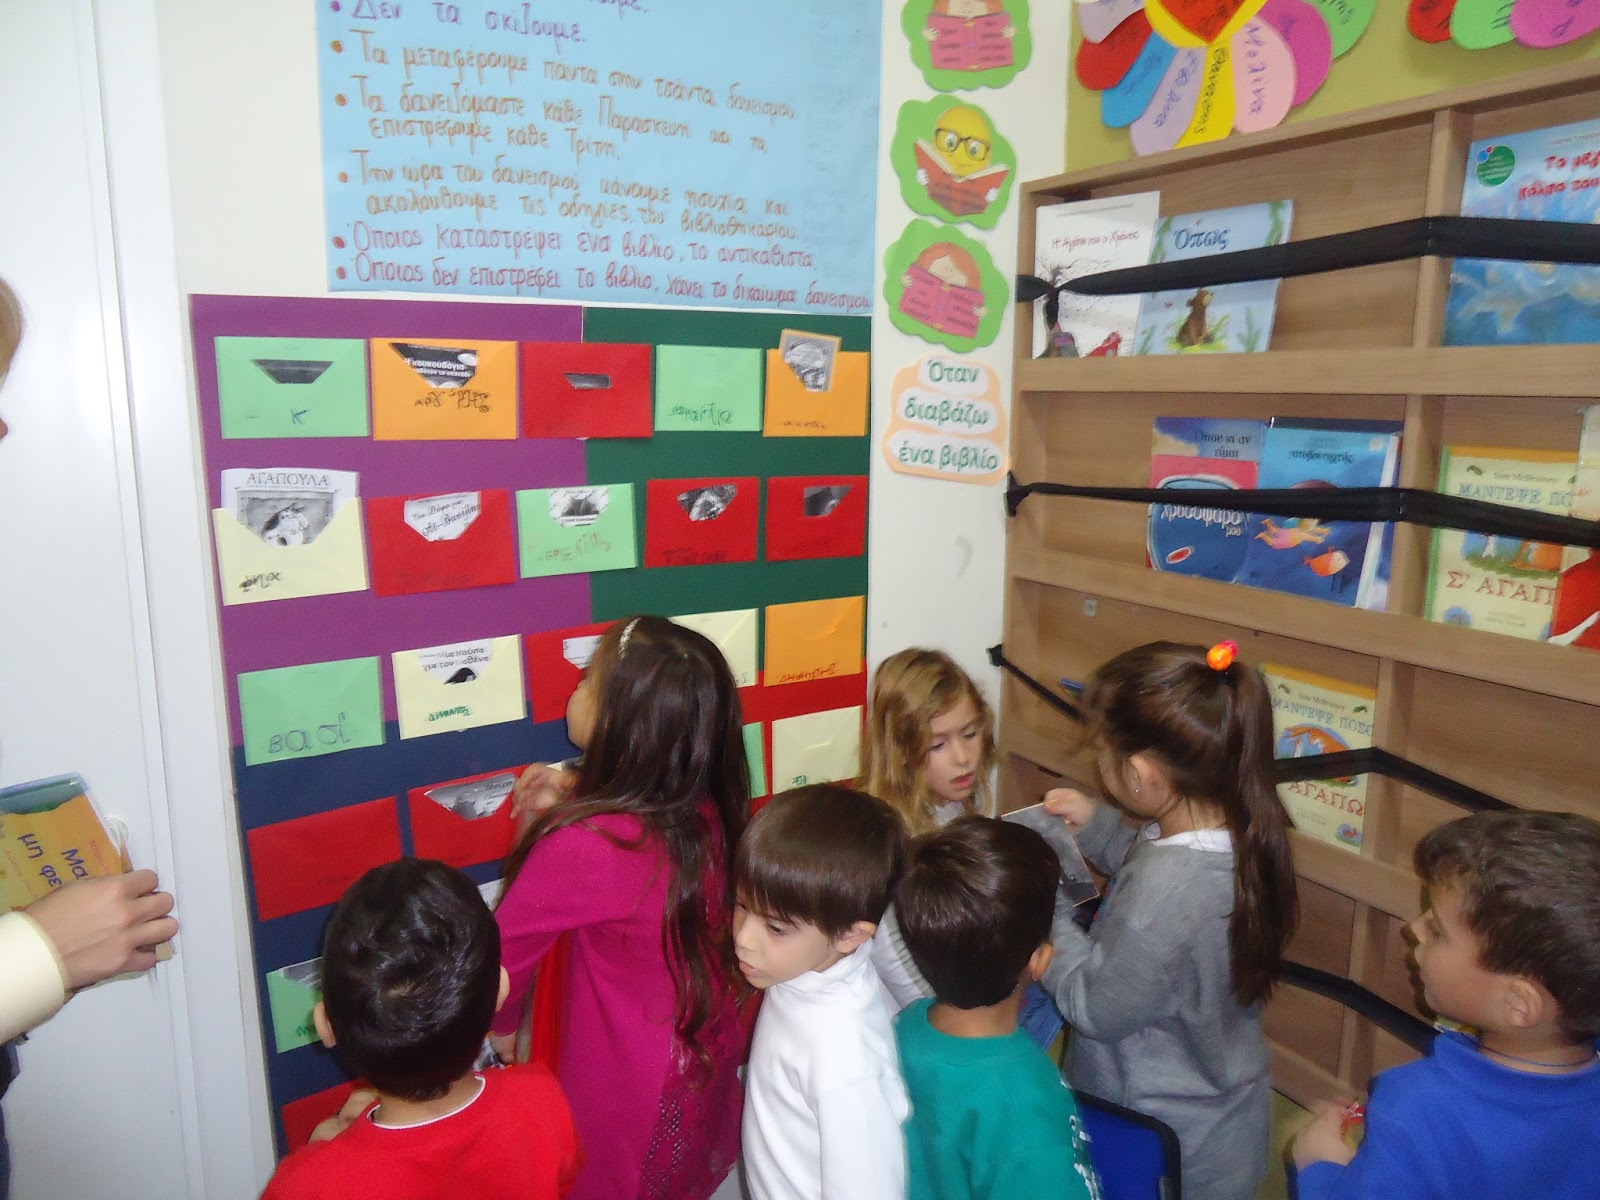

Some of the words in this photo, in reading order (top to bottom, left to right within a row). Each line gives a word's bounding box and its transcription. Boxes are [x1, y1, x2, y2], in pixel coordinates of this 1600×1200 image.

[352, 0, 400, 20] Δεν
[432, 2, 463, 25] τα
[348, 28, 388, 65] Τα
[350, 75, 387, 112] Τα
[350, 149, 395, 186] Την
[452, 163, 483, 184] του
[765, 198, 791, 216] και
[519, 195, 547, 217] τις
[687, 242, 709, 261] το
[1173, 227, 1232, 251] Όπως
[432, 256, 459, 286] δεν
[575, 267, 595, 289] το
[711, 281, 728, 298] το
[926, 359, 981, 384] Όταν
[903, 395, 990, 429] διαβάζω
[898, 440, 937, 465] ένα
[938, 444, 999, 472] βιβλίο
[246, 471, 329, 487] ΑΓΑΠΟΥΛΑ
[16, 831, 45, 860] μη
